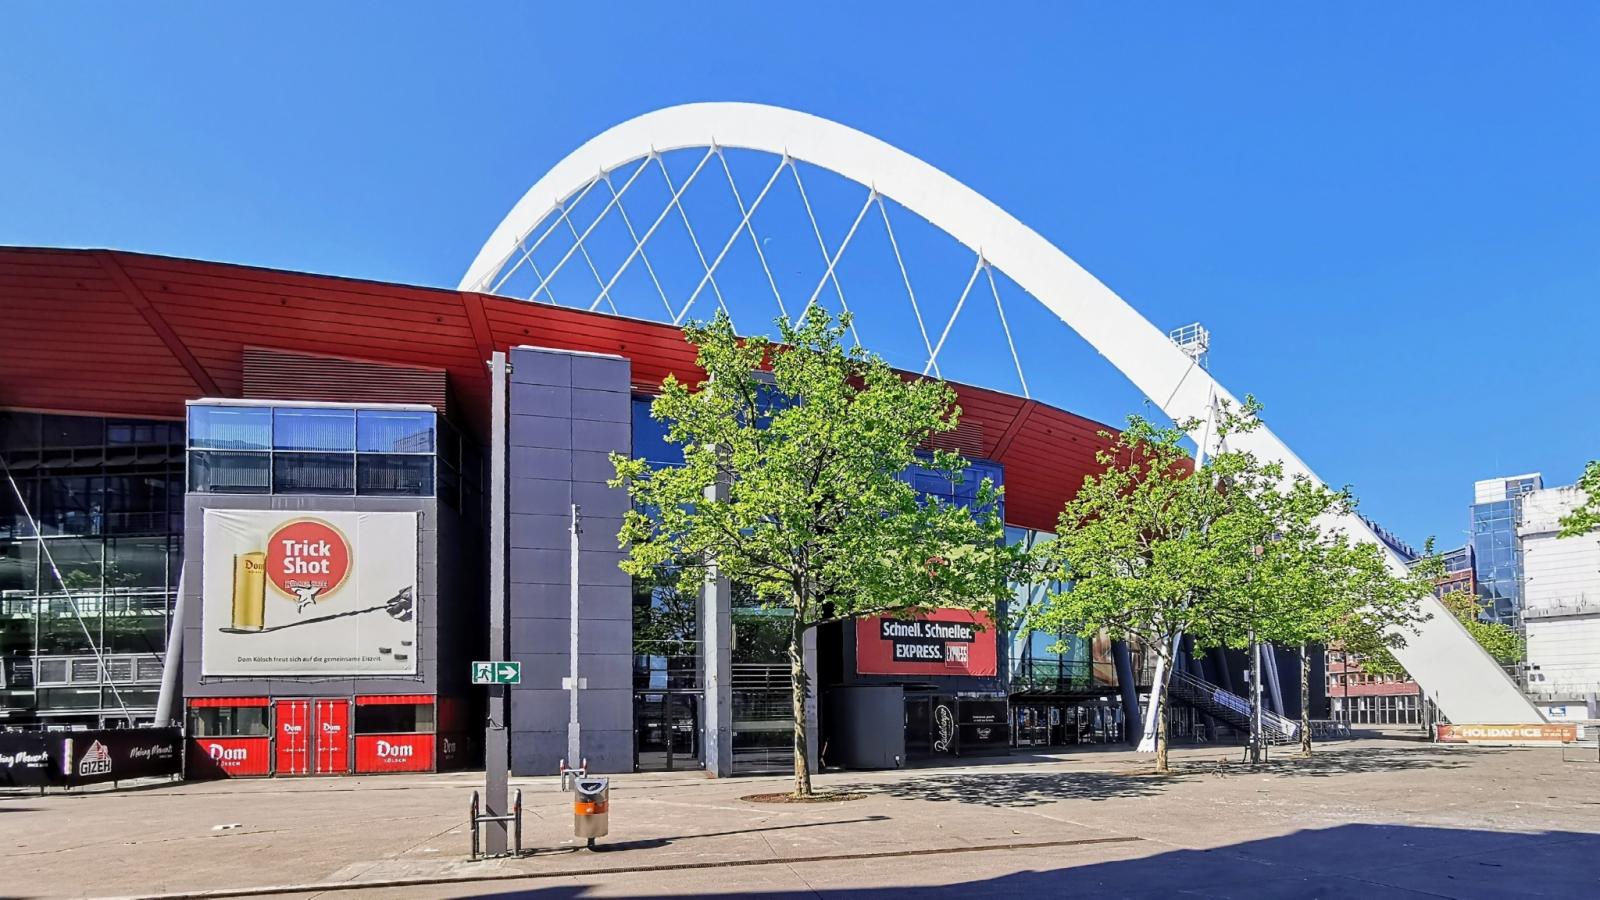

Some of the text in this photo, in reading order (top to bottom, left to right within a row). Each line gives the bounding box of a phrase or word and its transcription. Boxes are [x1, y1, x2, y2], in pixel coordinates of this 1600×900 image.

[282, 539, 331, 557] Trick
[283, 556, 330, 574] Shot
[883, 622, 973, 640] Schnell. Schneller.
[237, 655, 253, 663] Dom
[253, 655, 273, 663] Kölsch
[273, 655, 289, 663] freut
[289, 655, 302, 663] sich
[302, 655, 313, 663] auf
[313, 655, 323, 663] die
[323, 655, 361, 664] gemeinsame
[896, 644, 943, 659] EXPRESS.
[284, 723, 302, 732] Dom
[323, 722, 341, 731] Dom
[1462, 728, 1514, 737] HOLIDAY
[1520, 728, 1542, 737] ICE
[209, 743, 248, 760] Dom
[376, 740, 413, 757] Dom
[81, 759, 111, 775] GIZEH
